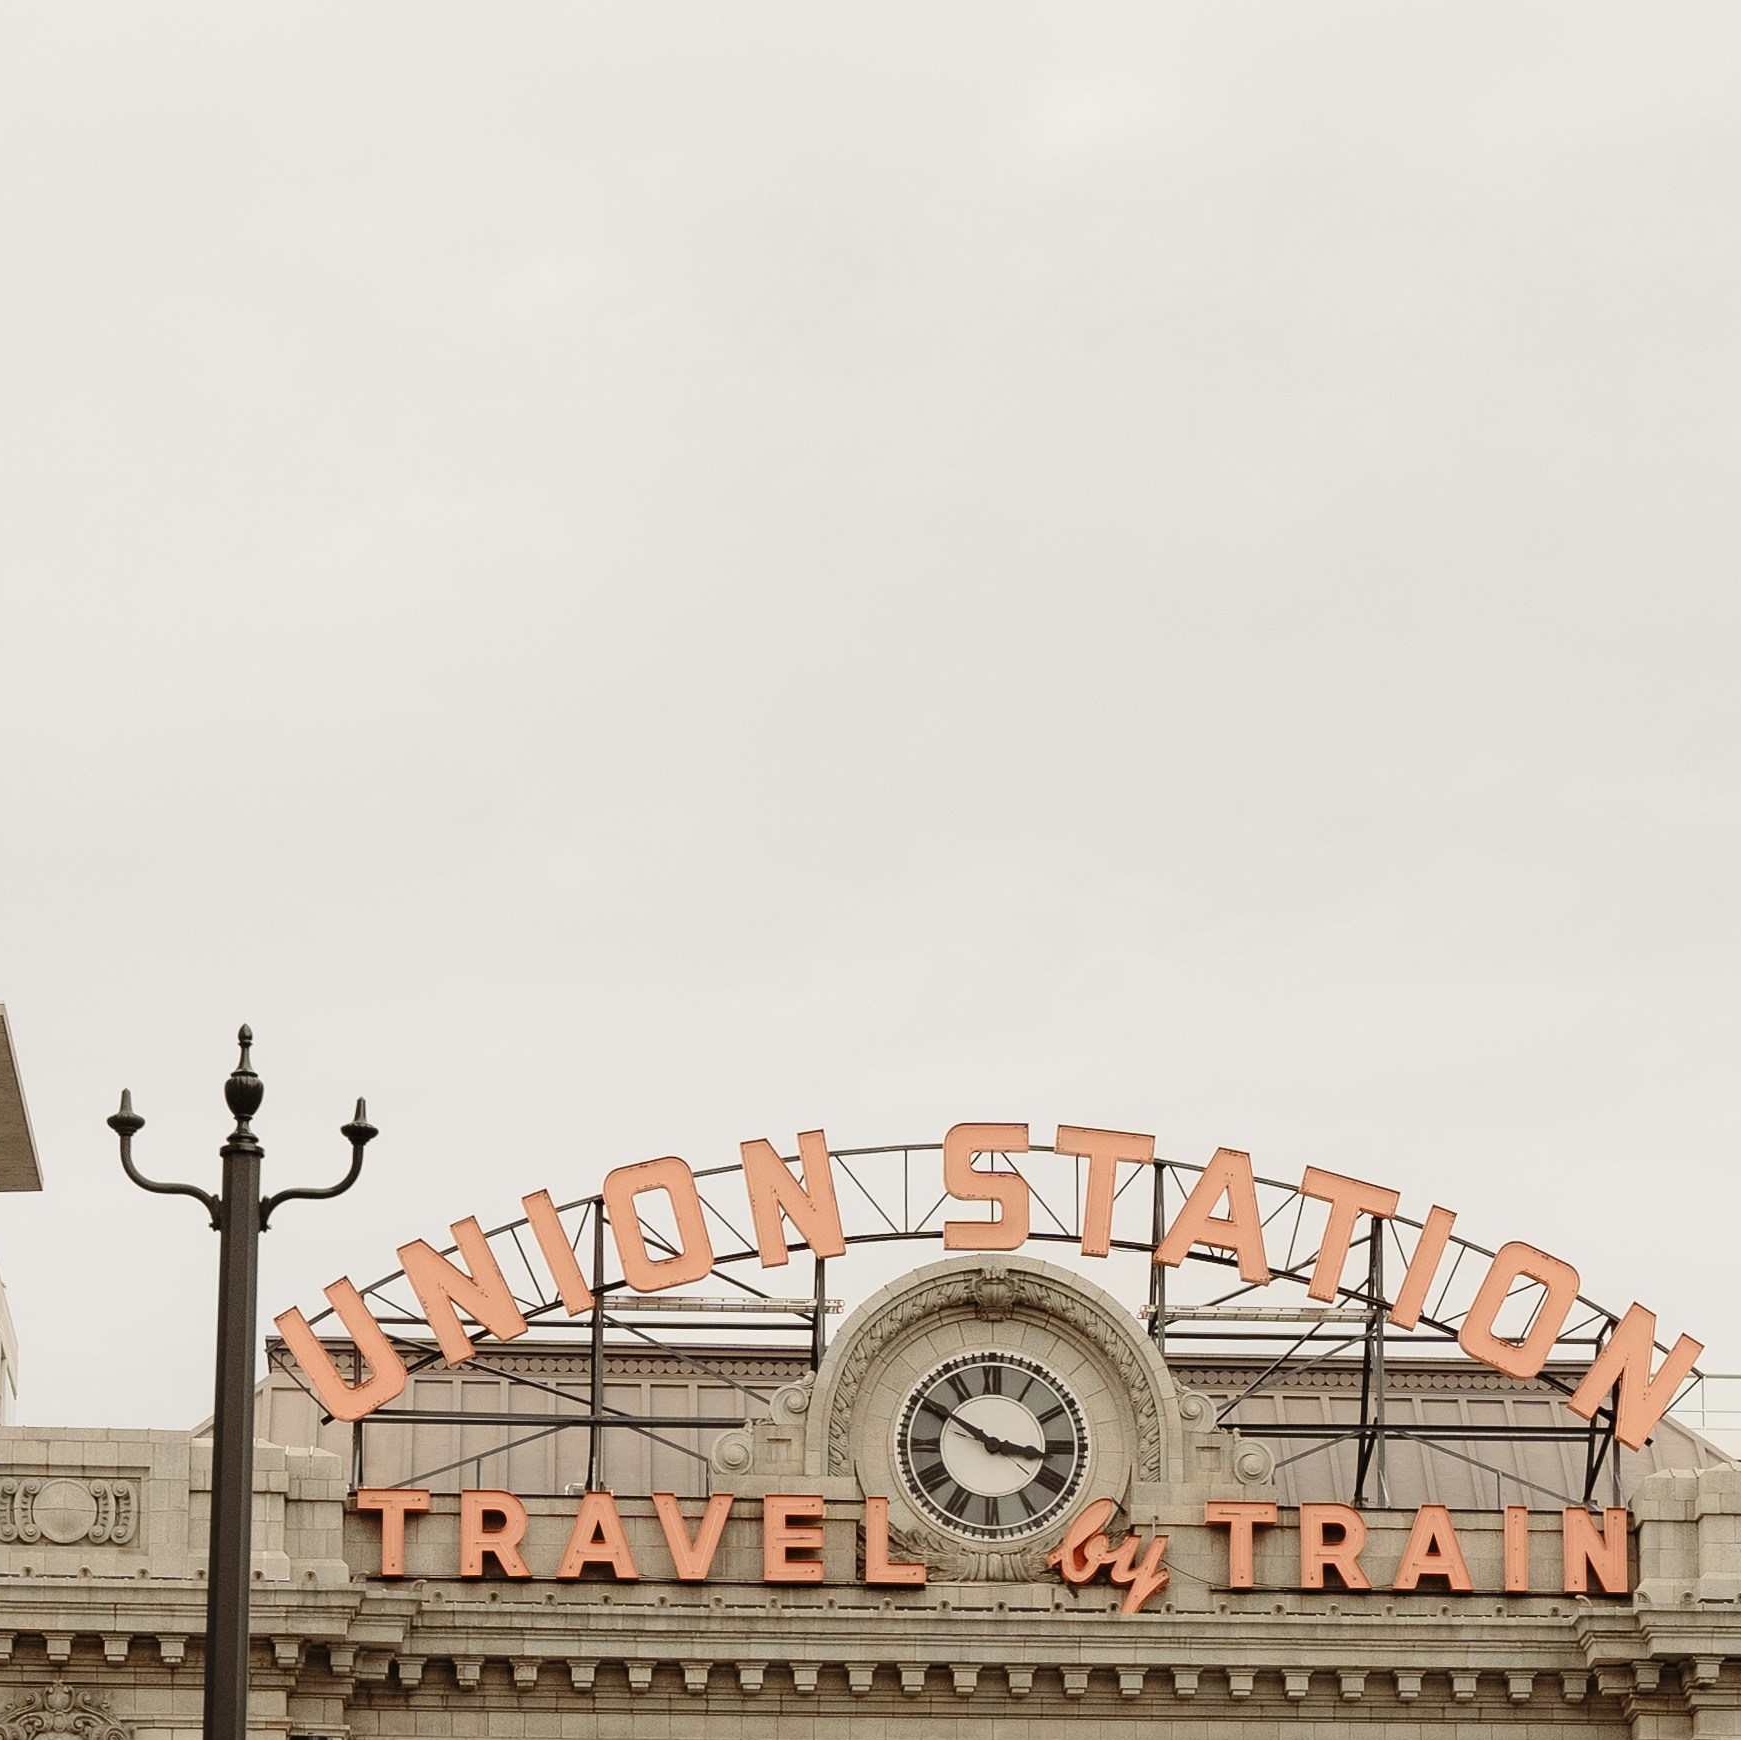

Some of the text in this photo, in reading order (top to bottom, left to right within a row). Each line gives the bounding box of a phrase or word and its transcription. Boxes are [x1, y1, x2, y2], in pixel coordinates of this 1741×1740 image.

[272, 1123, 1704, 1450] UNION STATION
[355, 1487, 1631, 1614] TRAVEL by TRAIN
